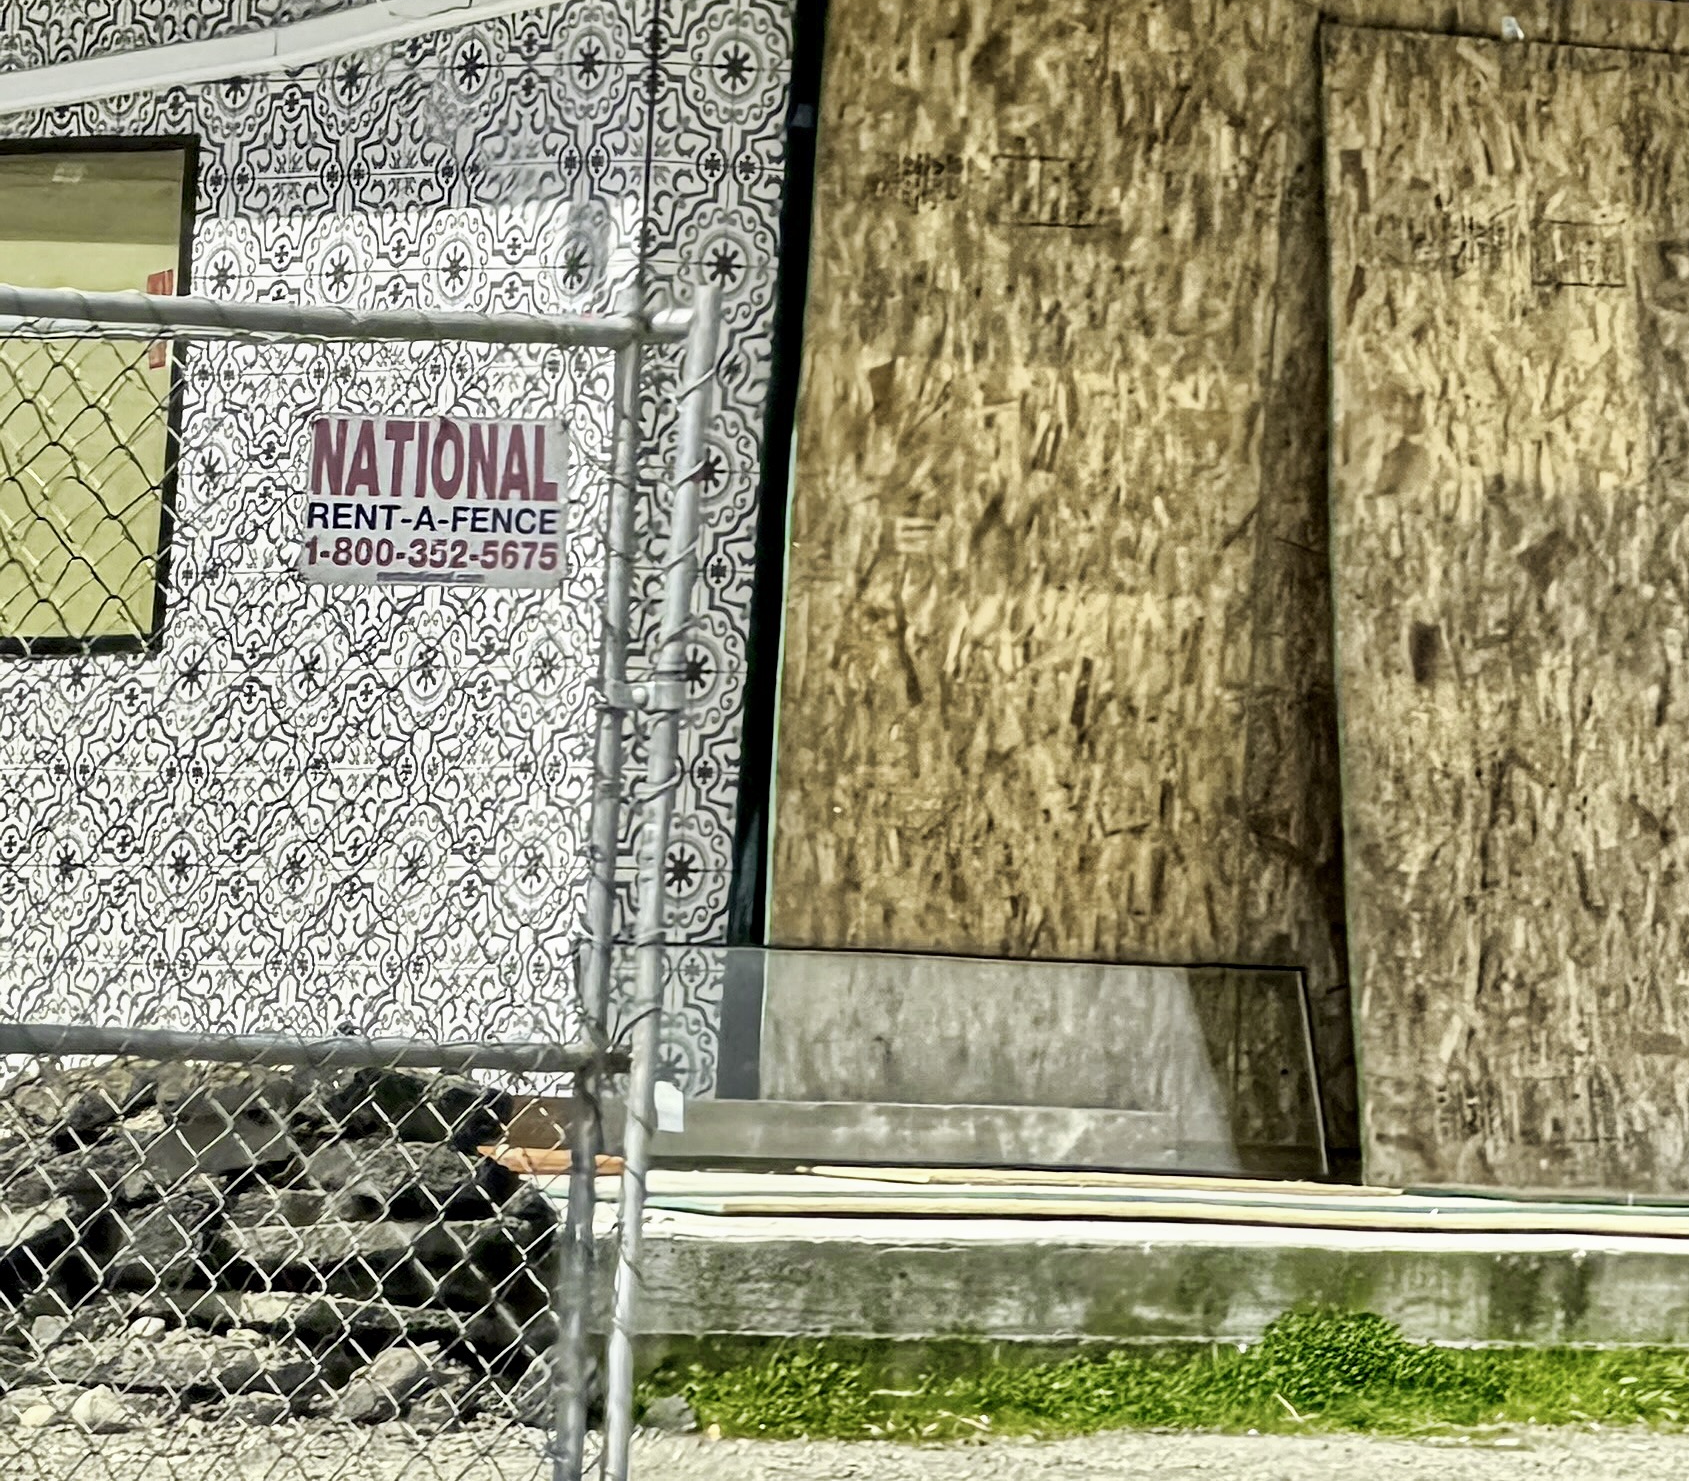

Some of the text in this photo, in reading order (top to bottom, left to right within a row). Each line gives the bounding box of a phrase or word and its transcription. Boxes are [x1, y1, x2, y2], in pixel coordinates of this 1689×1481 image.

[311, 418, 558, 501] NATIONAL
[307, 502, 560, 535] RENT-A-FENCE
[305, 535, 559, 570] 1-800-352-5675
